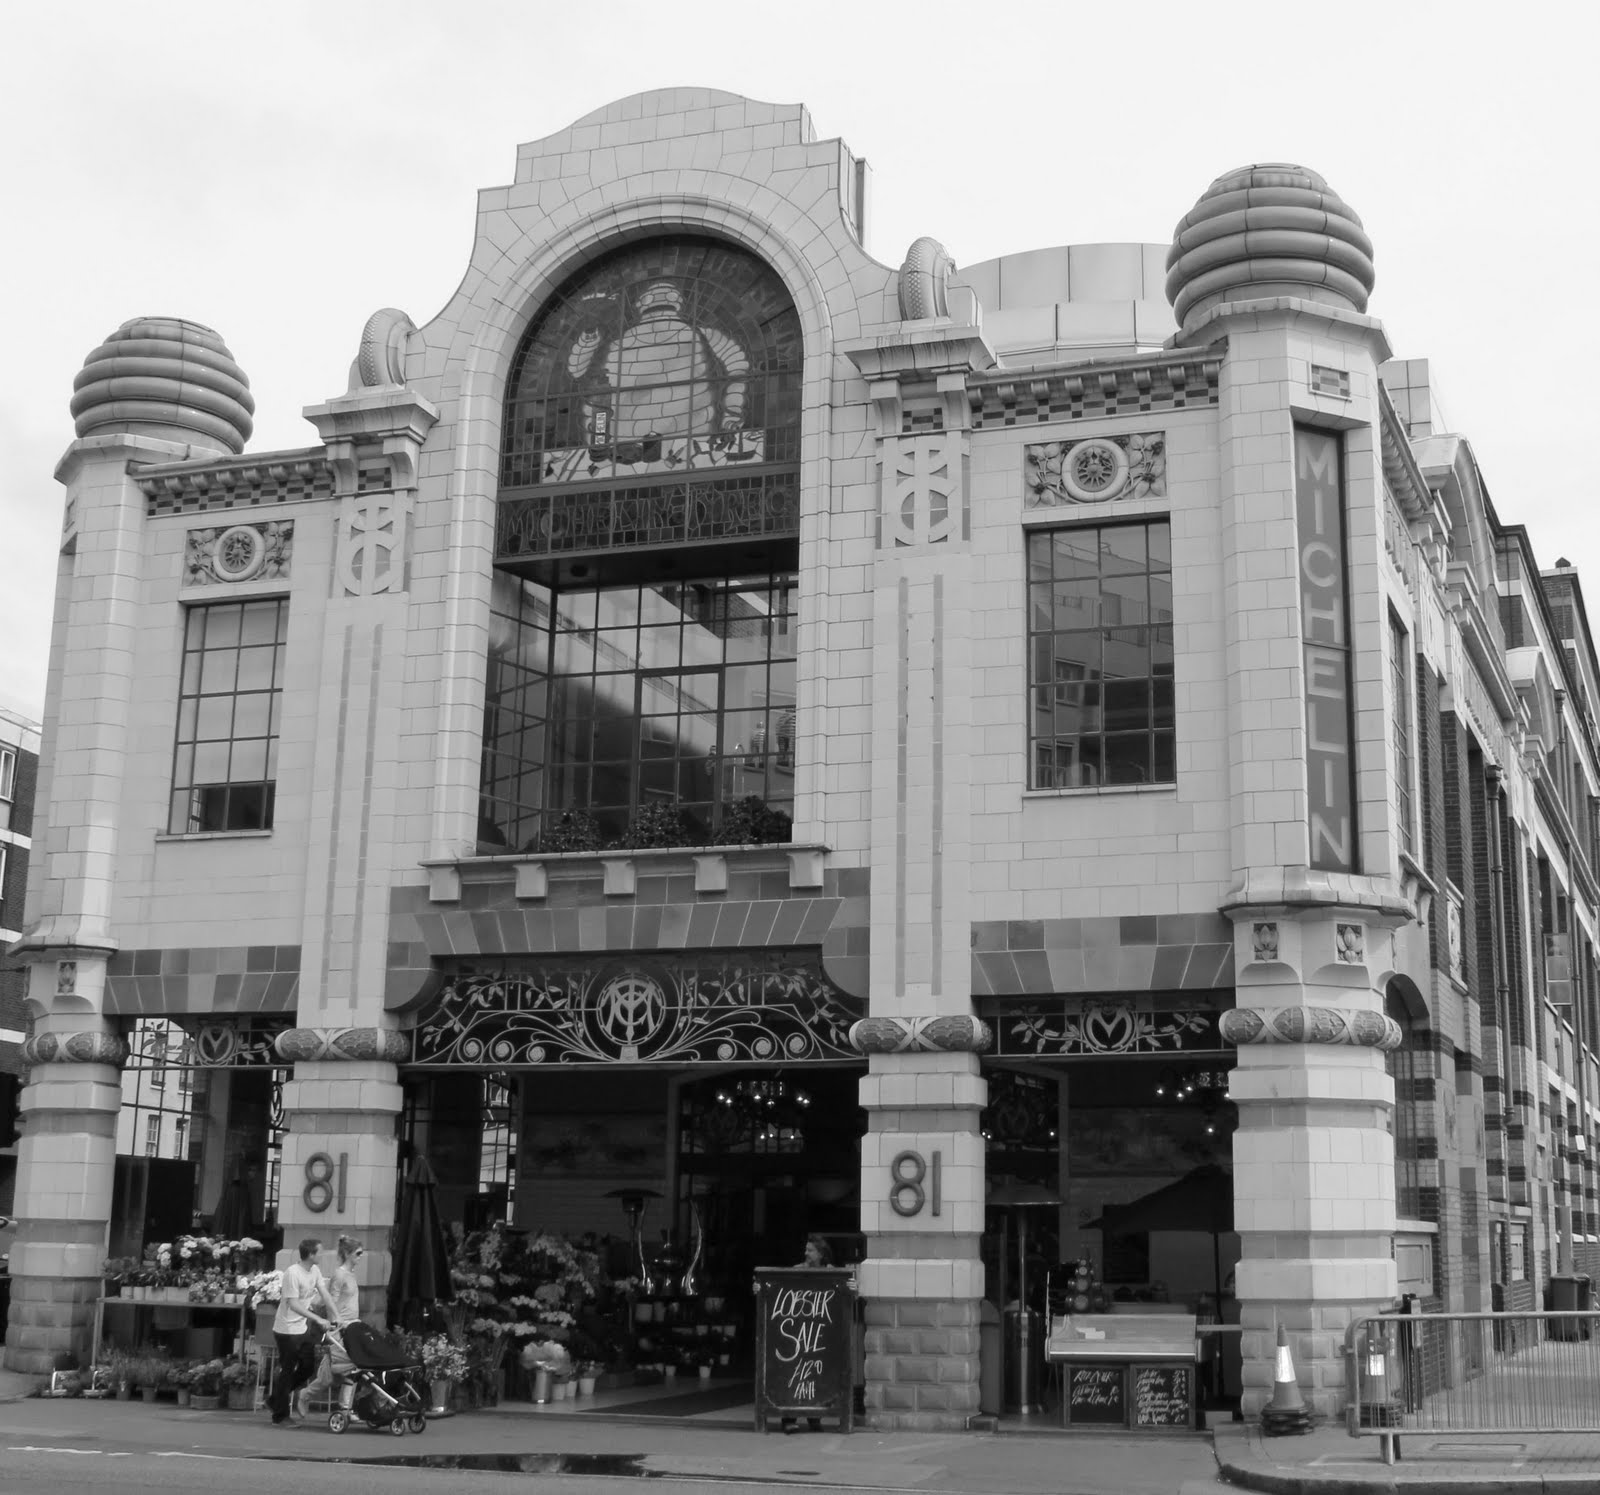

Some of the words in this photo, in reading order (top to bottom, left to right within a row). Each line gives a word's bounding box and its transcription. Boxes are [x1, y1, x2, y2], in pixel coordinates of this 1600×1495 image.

[1299, 438, 1349, 865] MICHELIN
[303, 1151, 349, 1214] 81
[889, 1149, 942, 1218] 81
[771, 1287, 836, 1324] LOBSTER
[775, 1317, 827, 1362] SALE
